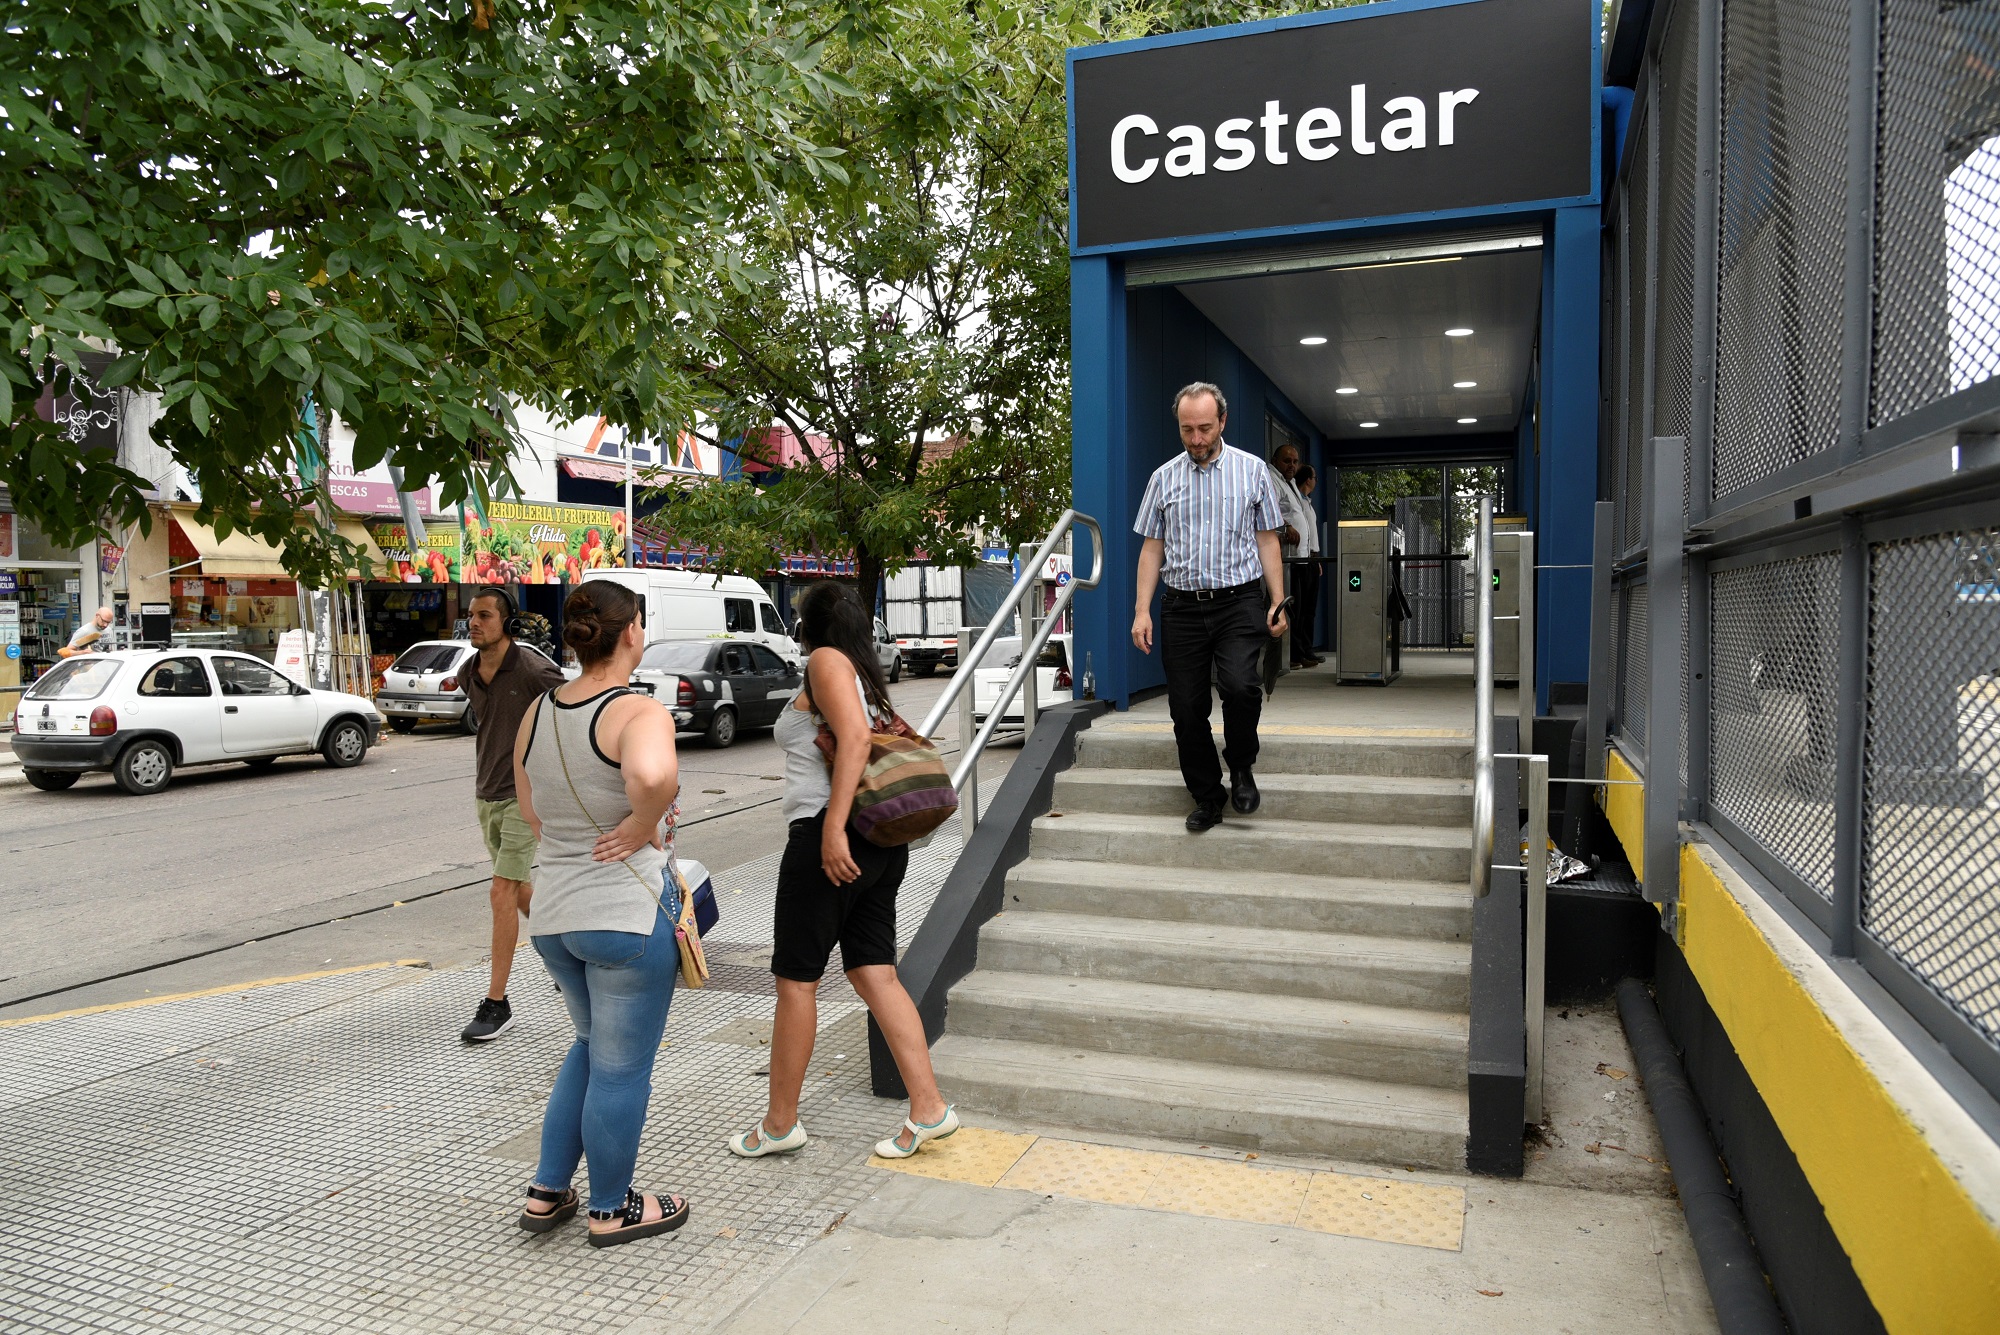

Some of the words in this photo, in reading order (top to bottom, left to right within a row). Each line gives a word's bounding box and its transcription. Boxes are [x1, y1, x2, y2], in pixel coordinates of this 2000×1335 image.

[1110, 83, 1480, 184] Castelar
[330, 484, 368, 498] ESCAS
[488, 501, 553, 524] VERDULERIA
[554, 508, 562, 523] Y
[563, 505, 612, 526] FRUTERÍA
[529, 523, 566, 544] Hilda
